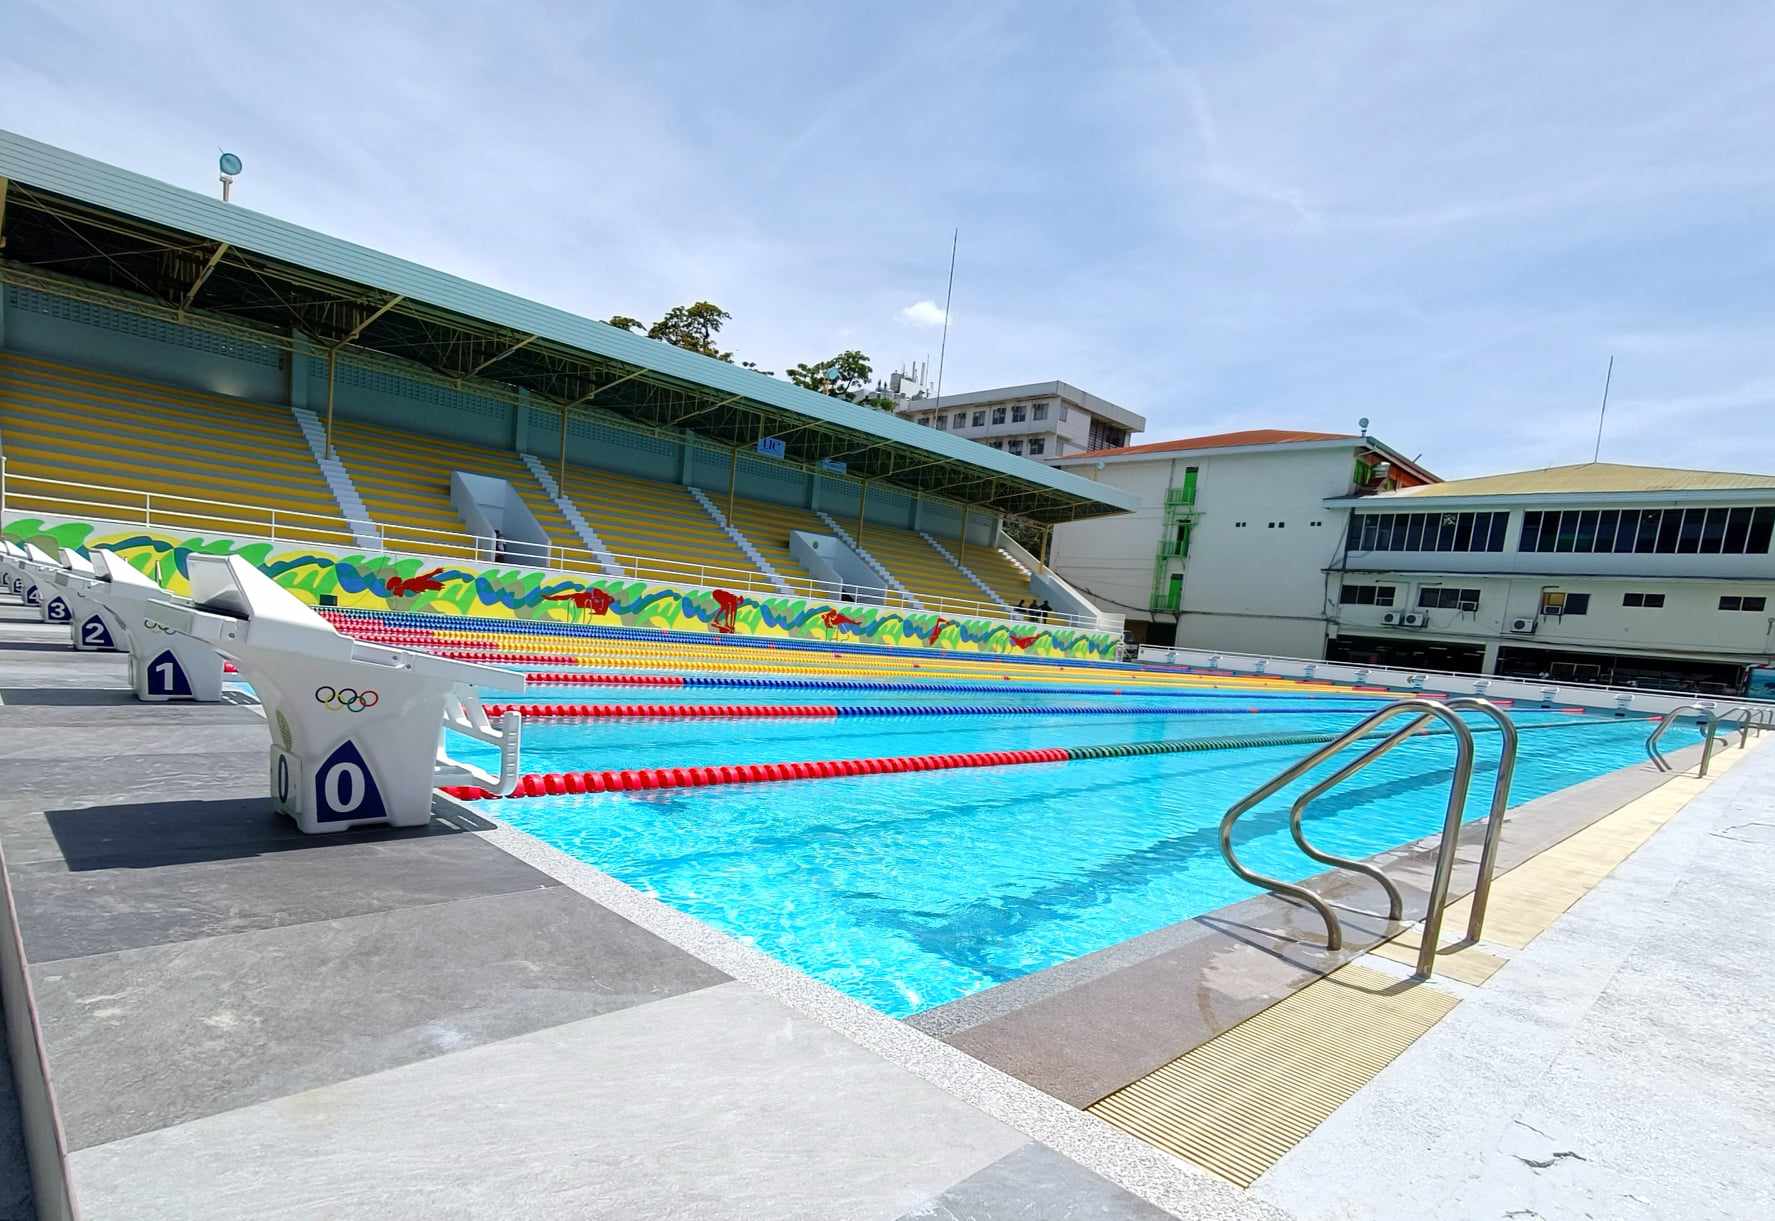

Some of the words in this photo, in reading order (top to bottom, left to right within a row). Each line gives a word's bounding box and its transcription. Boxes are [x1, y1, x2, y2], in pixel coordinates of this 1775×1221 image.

[29, 590, 40, 602] 4
[50, 602, 65, 618] 3
[85, 622, 105, 643] 2
[156, 662, 174, 691] 1
[325, 762, 365, 813] 0
